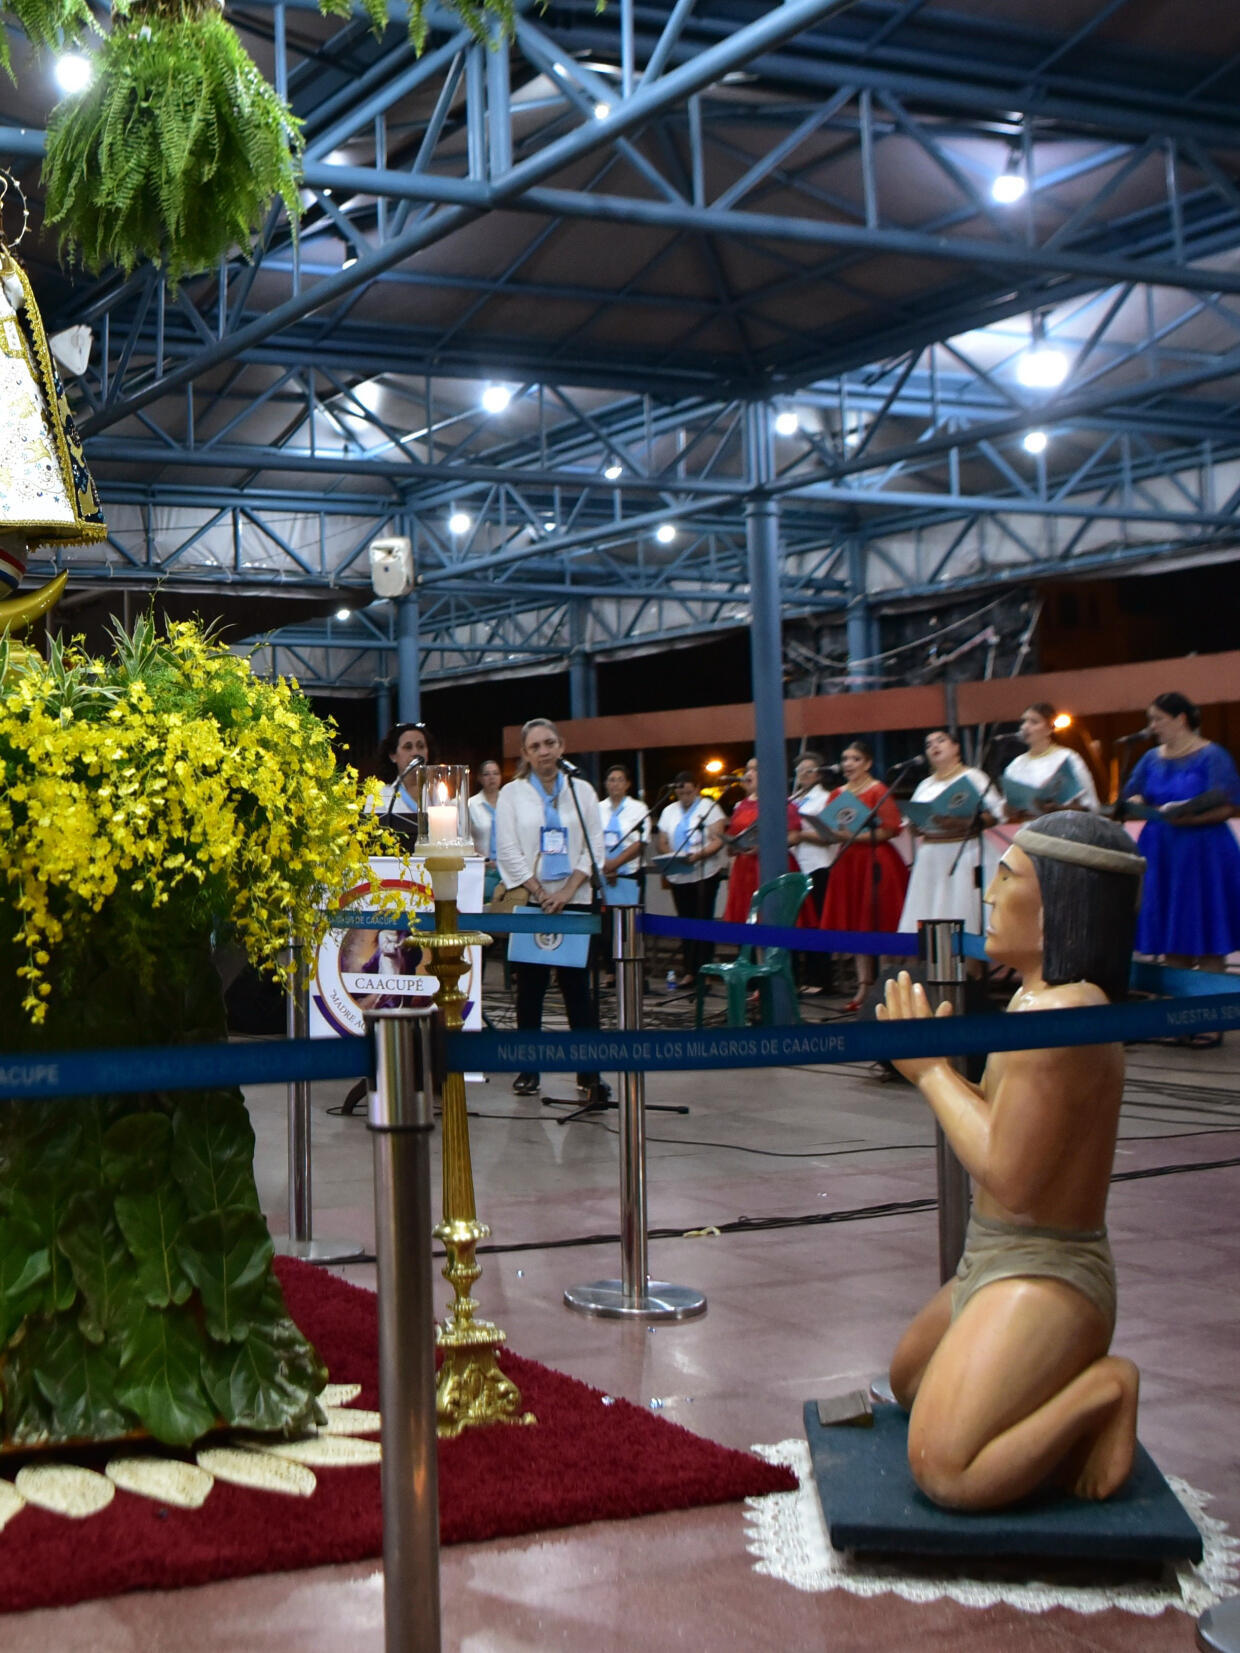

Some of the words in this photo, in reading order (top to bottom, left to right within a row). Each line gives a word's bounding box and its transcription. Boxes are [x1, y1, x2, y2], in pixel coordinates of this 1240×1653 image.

[354, 977, 425, 992] CAACUPÉ
[497, 1043, 567, 1062] NUESTRA
[632, 1042, 651, 1059] DE
[655, 1041, 683, 1058] LOS
[686, 1039, 757, 1058] MILAGROS
[760, 1038, 779, 1055] DE
[782, 1035, 845, 1054] CAACUPE
